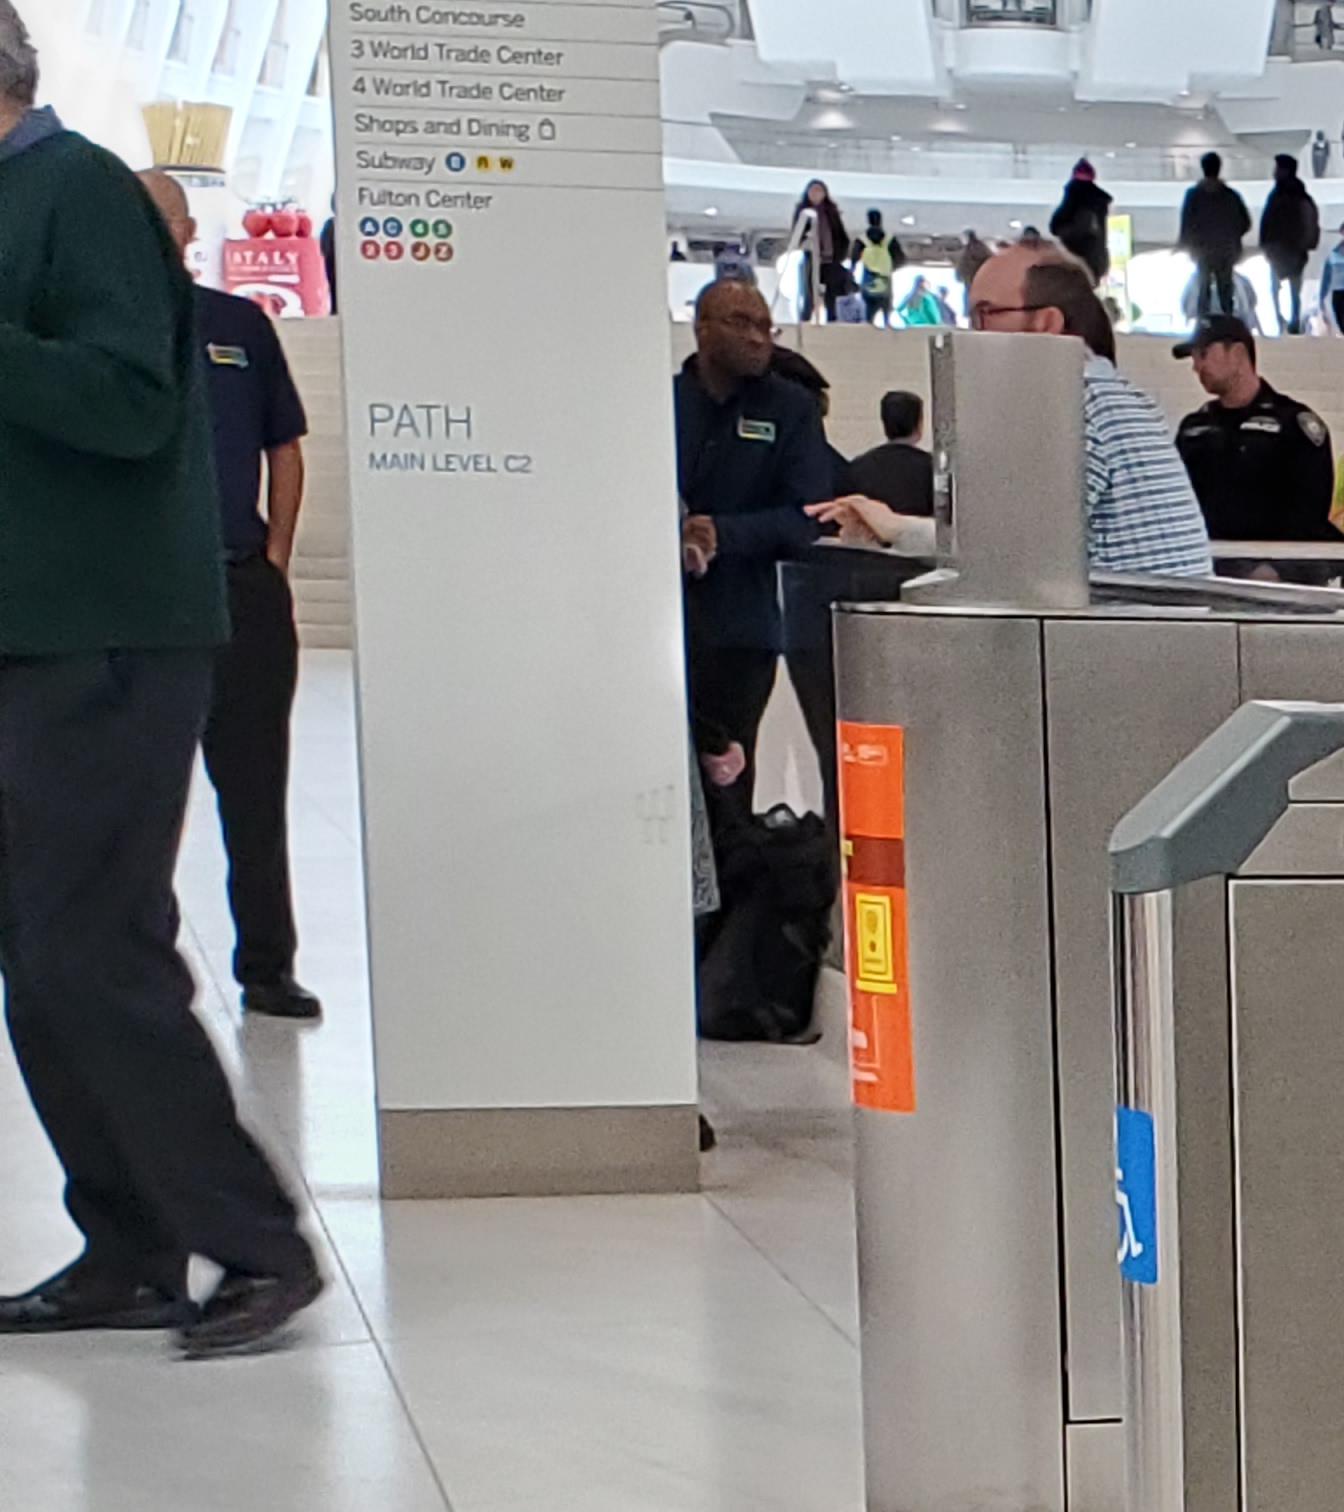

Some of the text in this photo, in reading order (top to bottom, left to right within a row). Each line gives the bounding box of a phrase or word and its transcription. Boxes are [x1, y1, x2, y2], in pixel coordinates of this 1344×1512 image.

[350, 3, 525, 28] South Concourse
[351, 40, 564, 66] 3 World Trade Center
[352, 77, 566, 102] 4 World Trade Center
[355, 113, 530, 142] Shops and Dining
[356, 150, 436, 175] Subway
[358, 187, 493, 210] Fulton Center
[369, 403, 472, 439] PATH
[368, 453, 534, 474] MAIN LEVEL C2
